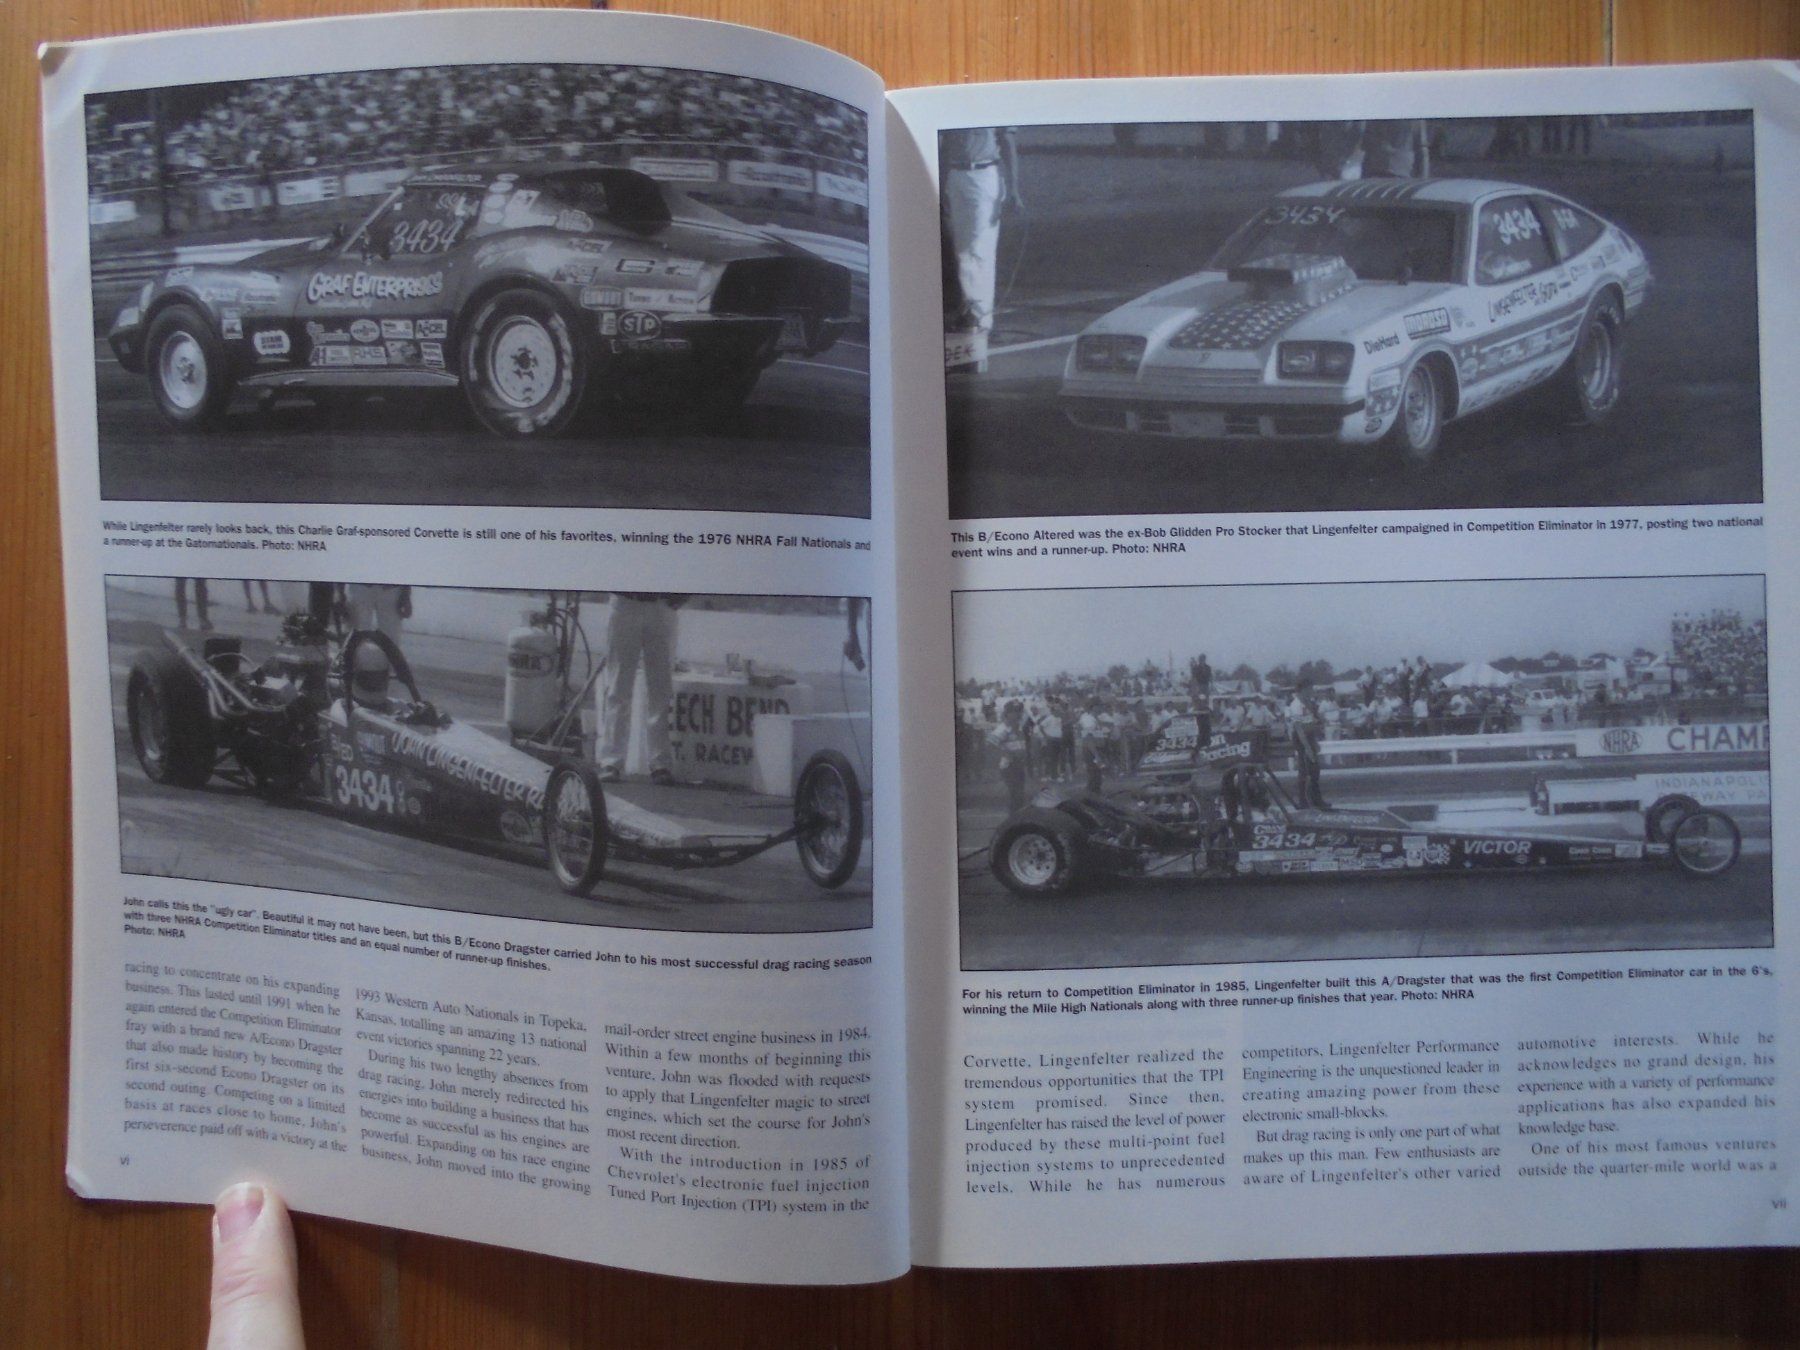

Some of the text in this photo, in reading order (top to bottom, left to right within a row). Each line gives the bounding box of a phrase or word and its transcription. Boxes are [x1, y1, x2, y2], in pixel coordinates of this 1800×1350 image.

[391, 217, 465, 252] 3434
[624, 313, 656, 334] STP
[1363, 333, 1400, 354] DieHard
[102, 520, 128, 530] While
[128, 521, 184, 533] Lingenfelter
[185, 523, 212, 535] rarely
[214, 523, 243, 534] looks
[274, 524, 296, 534] this
[296, 524, 333, 535] Charlie
[335, 525, 411, 537] Graf-sponsored
[413, 526, 459, 538] Corvette
[462, 527, 472, 538] is
[474, 528, 497, 539] still
[499, 531, 522, 540] one
[524, 529, 537, 540] of
[538, 529, 557, 540] his
[620, 531, 669, 545] winning
[672, 532, 694, 543] the
[697, 533, 732, 544] 1976
[735, 534, 772, 546] NHRA
[776, 535, 798, 547] Fall
[800, 536, 852, 549] Nationals
[854, 540, 871, 551] and
[950, 532, 974, 543] This
[977, 531, 1030, 543] B/Econo
[1032, 529, 1075, 540] Altered
[1077, 530, 1102, 539] was
[1104, 528, 1124, 538] the
[1126, 527, 1166, 538] ex-Bob
[1169, 526, 1212, 537] Glidden
[1215, 526, 1234, 536] Pro
[1237, 525, 1282, 536] Stocker
[1285, 525, 1308, 535] that
[1311, 524, 1378, 536] Lingenfelter
[1380, 522, 1450, 535] campaigned
[1452, 521, 1463, 532] in
[1466, 521, 1535, 533] Competition
[1537, 520, 1593, 530] Eliminator
[1596, 519, 1606, 529] in
[1646, 518, 1688, 530] posting
[1691, 518, 1714, 528] two
[1716, 516, 1764, 527] national
[950, 547, 983, 558] event
[986, 546, 1013, 556] wins
[1016, 545, 1038, 556] and
[1040, 547, 1048, 555] a
[1111, 543, 1149, 554] Photo:
[1152, 542, 1186, 552] NHRA
[1602, 728, 1641, 753] NHRA
[335, 764, 394, 814] 3434
[1252, 832, 1317, 849] 3434
[1464, 840, 1532, 854] VICTOR
[123, 923, 186, 938] Photo: NHRA
[961, 988, 981, 999] For
[984, 988, 1002, 999] his
[1007, 989, 1042, 998] return
[1046, 988, 1059, 998] to
[1063, 985, 1134, 998] Competition
[1137, 983, 1195, 994] Eliminator
[1199, 981, 1210, 992] in
[1254, 978, 1321, 992] Lingenfelter
[1324, 977, 1350, 988] built
[1354, 976, 1377, 987] this
[1380, 975, 1446, 987] A/Dragster
[1450, 974, 1474, 984] that
[1478, 975, 1501, 983] was
[1505, 972, 1524, 983] the
[1528, 971, 1552, 982] first
[1555, 969, 1623, 981] Competition
[1627, 967, 1684, 978] Eliminator
[1688, 968, 1708, 977] car
[1712, 966, 1722, 976] in
[1727, 966, 1746, 976] the
[356, 987, 380, 1003] 1993
[385, 992, 428, 1010] Western
[433, 1000, 460, 1015] Auto
[464, 1004, 519, 1023] Nationals
[523, 1011, 535, 1025] in
[604, 1023, 670, 1039] mail-order
[674, 1030, 708, 1042] street
[712, 1030, 756, 1046] engine
[761, 1030, 816, 1044] business
[820, 1029, 832, 1043] in
[1039, 1052, 1129, 1069] Lingenfelter
[1136, 1048, 1195, 1063] realized
[1201, 1047, 1224, 1060] the
[1328, 1041, 1411, 1058] Lingenfelter
[1416, 1040, 1500, 1053] Performance
[1517, 1056, 1616, 1072] acknowledges
[1623, 1057, 1641, 1068] no
[1647, 1053, 1688, 1070] grand
[1753, 1052, 1774, 1066] his
[660, 1068, 691, 1083] John
[697, 1074, 722, 1086] was
[728, 1073, 778, 1087] flooded
[785, 1073, 813, 1087] with
[819, 1072, 870, 1088] requests
[964, 1068, 1223, 1090] tremendous opportunities that the TPI
[1242, 1081, 1500, 1102] creating amazing power from these
[965, 1131, 1224, 1155] produced by these multi-point fuel
[619, 1146, 869, 1172] With the introduction in 1985 of
[1518, 1158, 1776, 1177] outside the quarter-mile world was a
